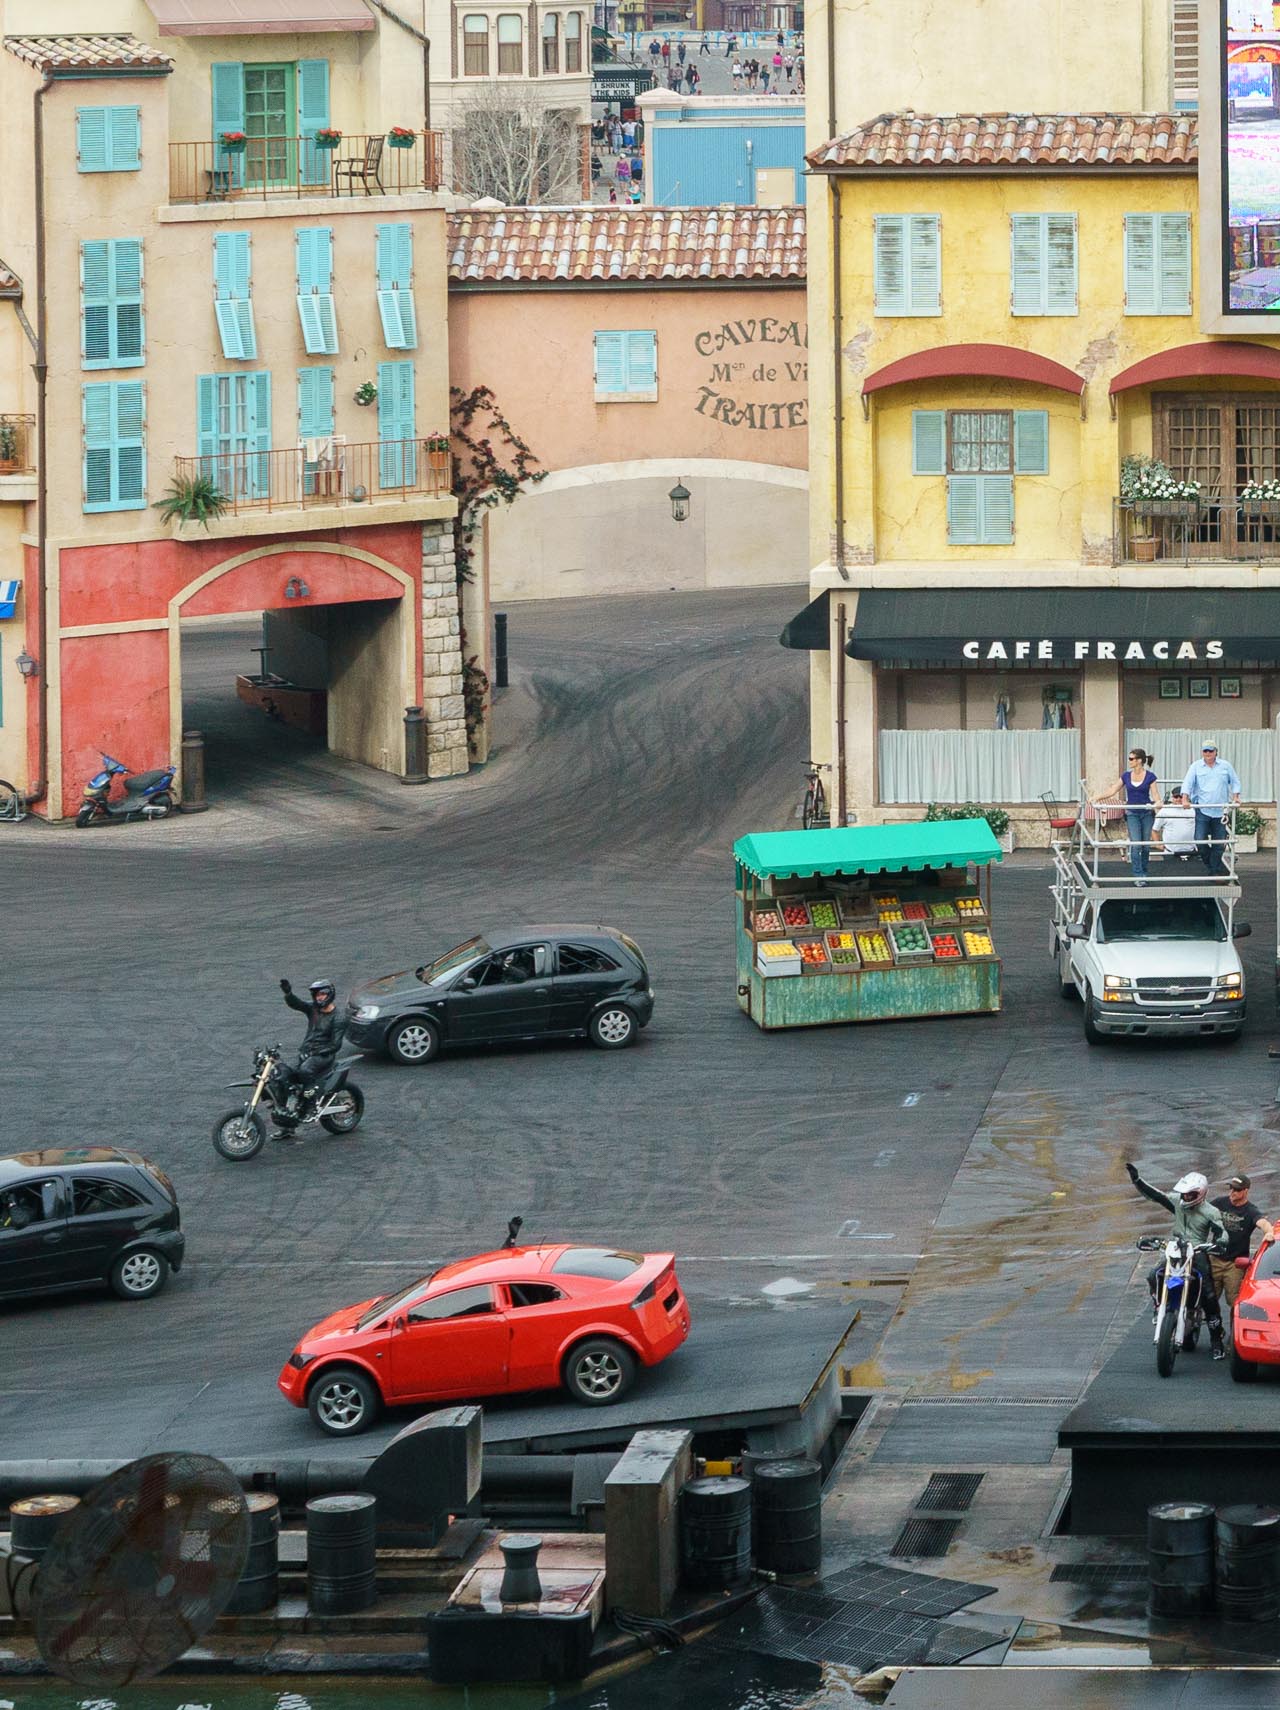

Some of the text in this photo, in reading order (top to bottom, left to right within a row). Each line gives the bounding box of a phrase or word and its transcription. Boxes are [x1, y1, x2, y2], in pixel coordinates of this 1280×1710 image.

[695, 317, 808, 356] CAVEA
[752, 363, 777, 382] de
[694, 385, 808, 430] TRAITE
[963, 639, 1224, 660] CAFÉ FRACAS
